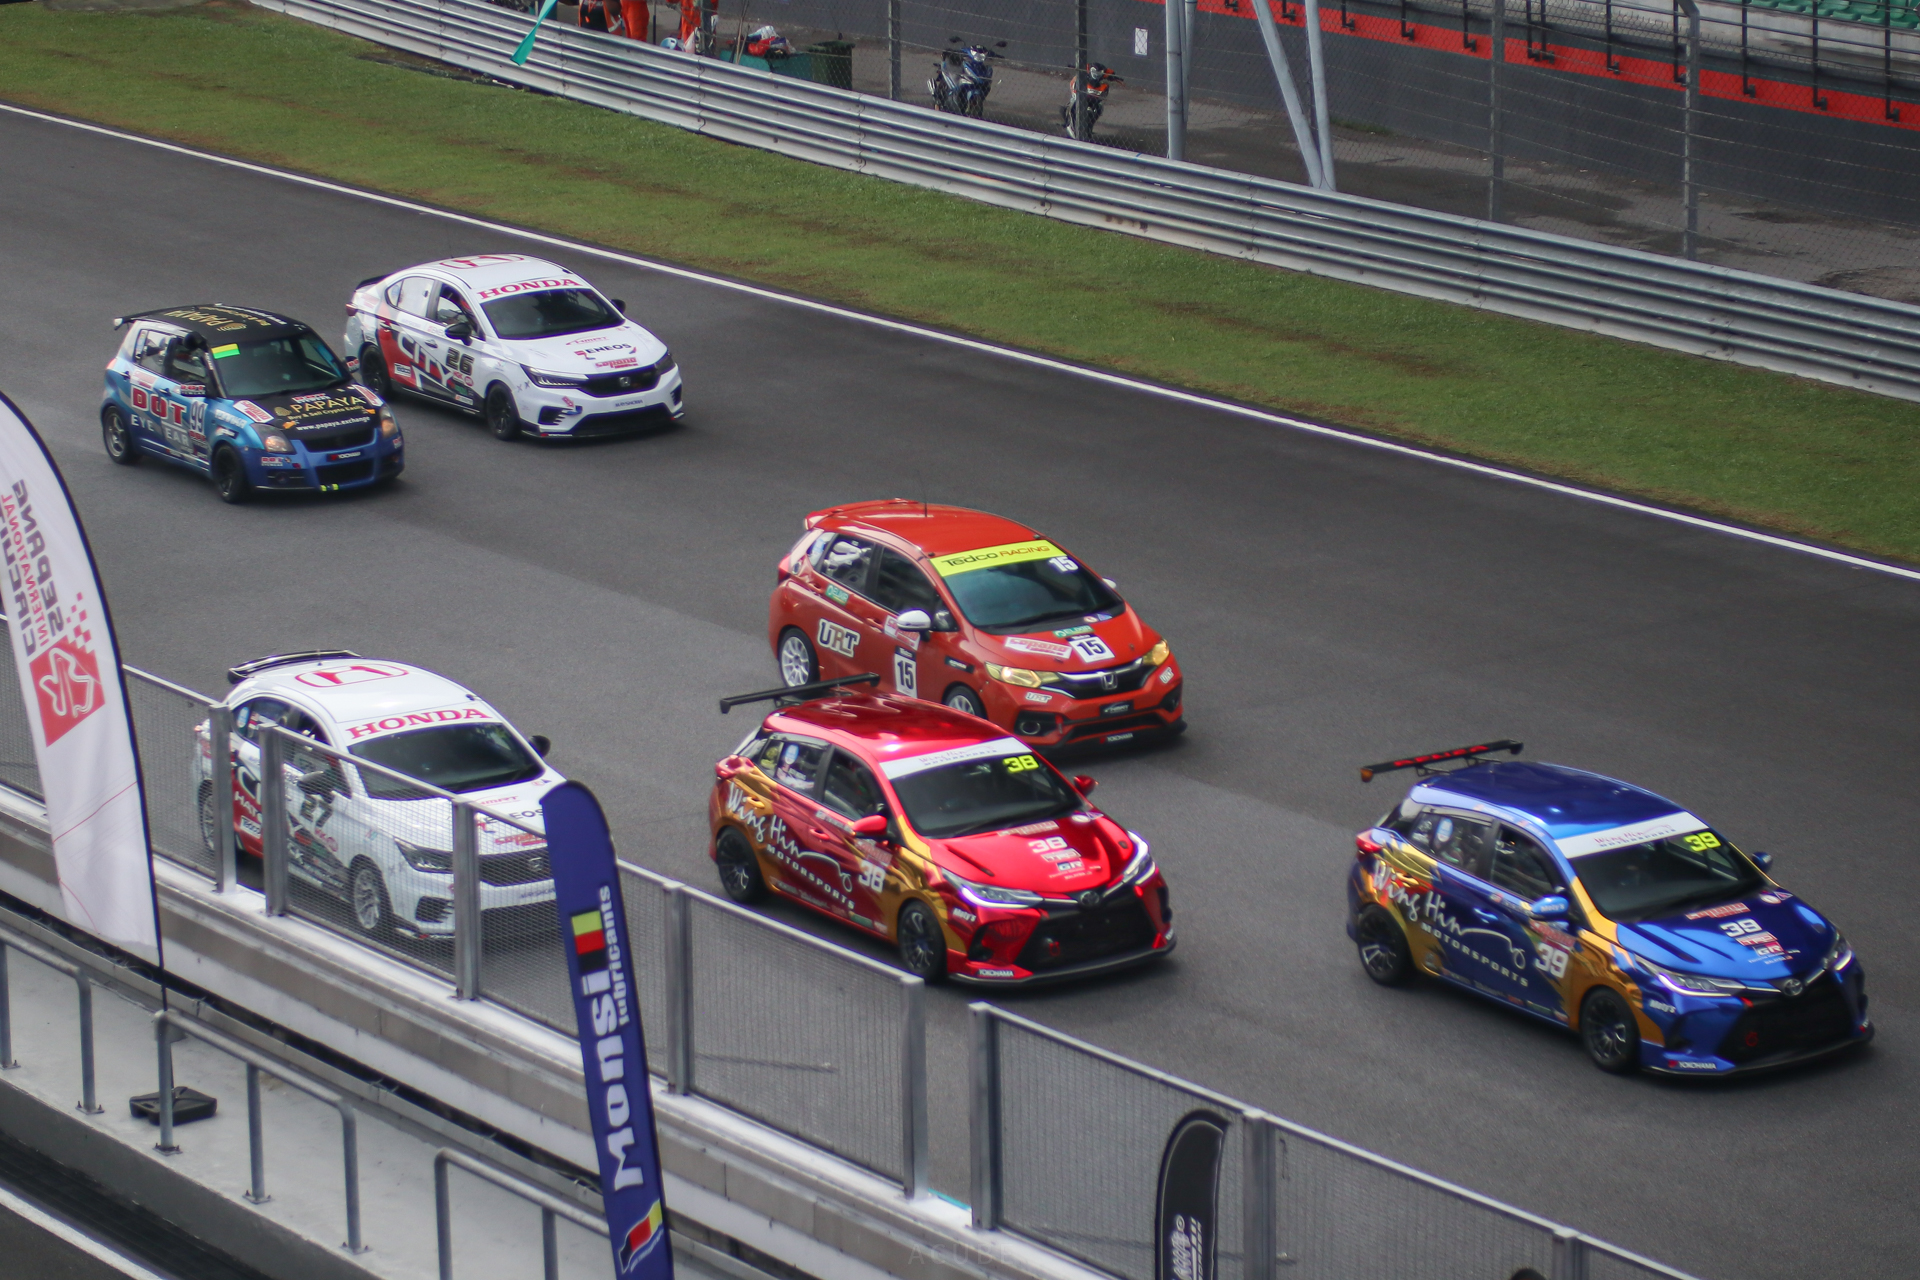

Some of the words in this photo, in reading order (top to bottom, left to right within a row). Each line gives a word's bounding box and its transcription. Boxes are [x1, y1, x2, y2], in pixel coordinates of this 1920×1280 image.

[477, 278, 583, 299] HONDA
[398, 331, 453, 388] CITY
[446, 346, 475, 377] 26
[585, 343, 632, 354] ENEOS
[132, 386, 188, 426] DOT
[189, 400, 207, 434] 99
[290, 395, 367, 413] PAPAYA
[296, 415, 371, 432] www.papaya.exchange
[999, 545, 1051, 558] RACING
[1047, 556, 1080, 572] 15
[818, 619, 860, 658] URT
[1077, 638, 1107, 656] 15
[898, 660, 915, 690] 15
[345, 708, 493, 739] HONDA
[1003, 755, 1040, 773] 38
[726, 782, 767, 843] Wing
[1027, 836, 1068, 854] 38
[1684, 832, 1722, 852] 39
[767, 843, 856, 910] MOTORSPORTS
[858, 859, 887, 894] 38
[1373, 859, 1422, 922] Wing
[1719, 918, 1763, 937] 39
[599, 885, 630, 1026] lubricants
[1421, 921, 1529, 988] MOTORSPORTS
[1534, 942, 1570, 979] 39
[978, 969, 1015, 978] YOKOHAMA
[581, 968, 644, 1191] Monsi
[1678, 1061, 1717, 1070] YOKOHAMA
